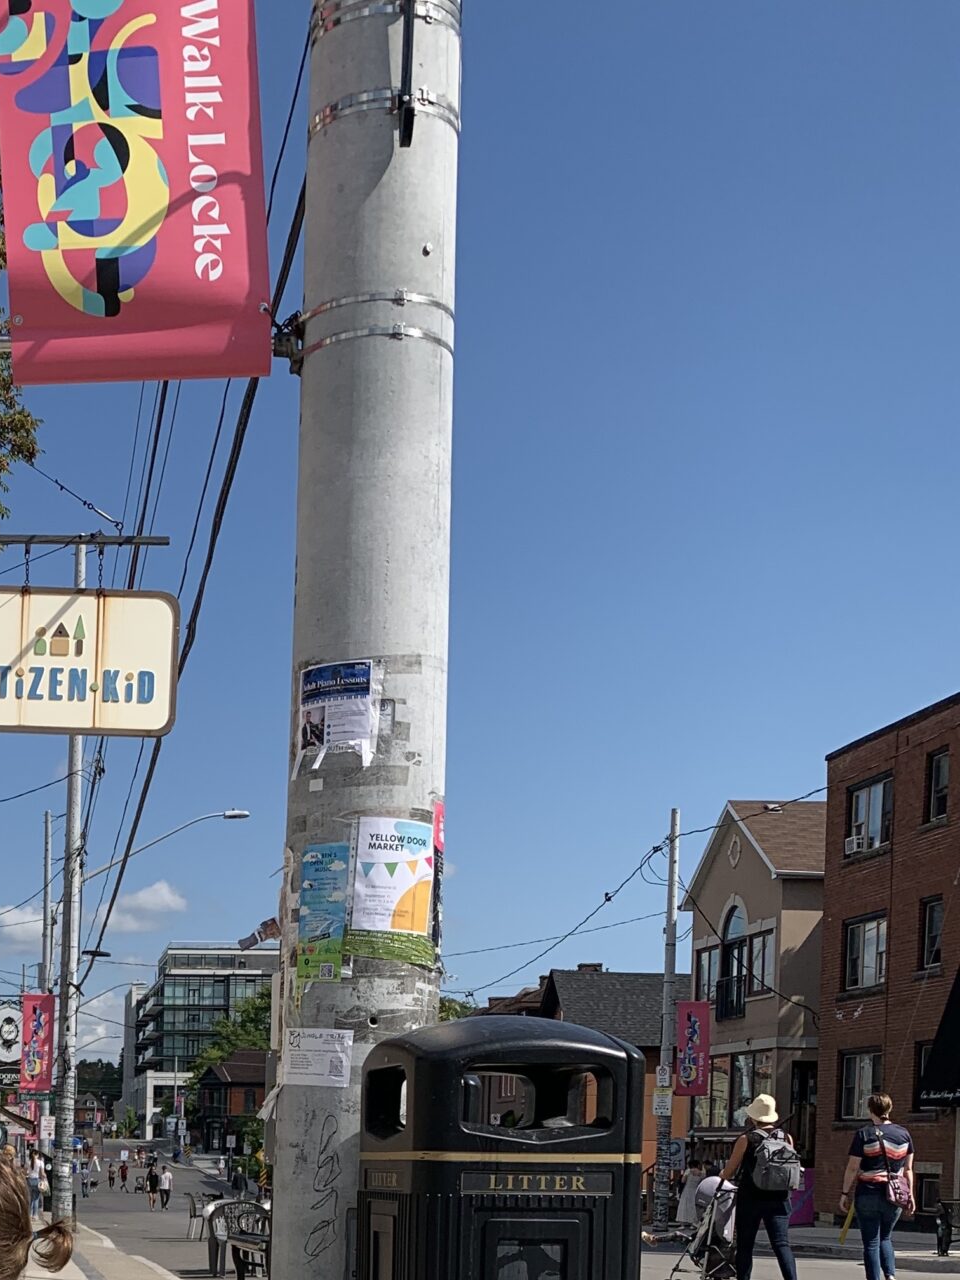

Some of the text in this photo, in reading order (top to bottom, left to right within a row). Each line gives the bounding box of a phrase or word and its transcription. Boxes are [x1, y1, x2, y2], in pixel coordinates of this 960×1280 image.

[180, 0, 232, 282] Walk Locke
[317, 679, 336, 688] Piano
[336, 676, 367, 685] Lessons
[368, 842, 405, 852] MARKET
[369, 833, 427, 847] YELLOW DOOR
[371, 1172, 397, 1187] LITTER
[489, 1174, 586, 1190] LITTER
